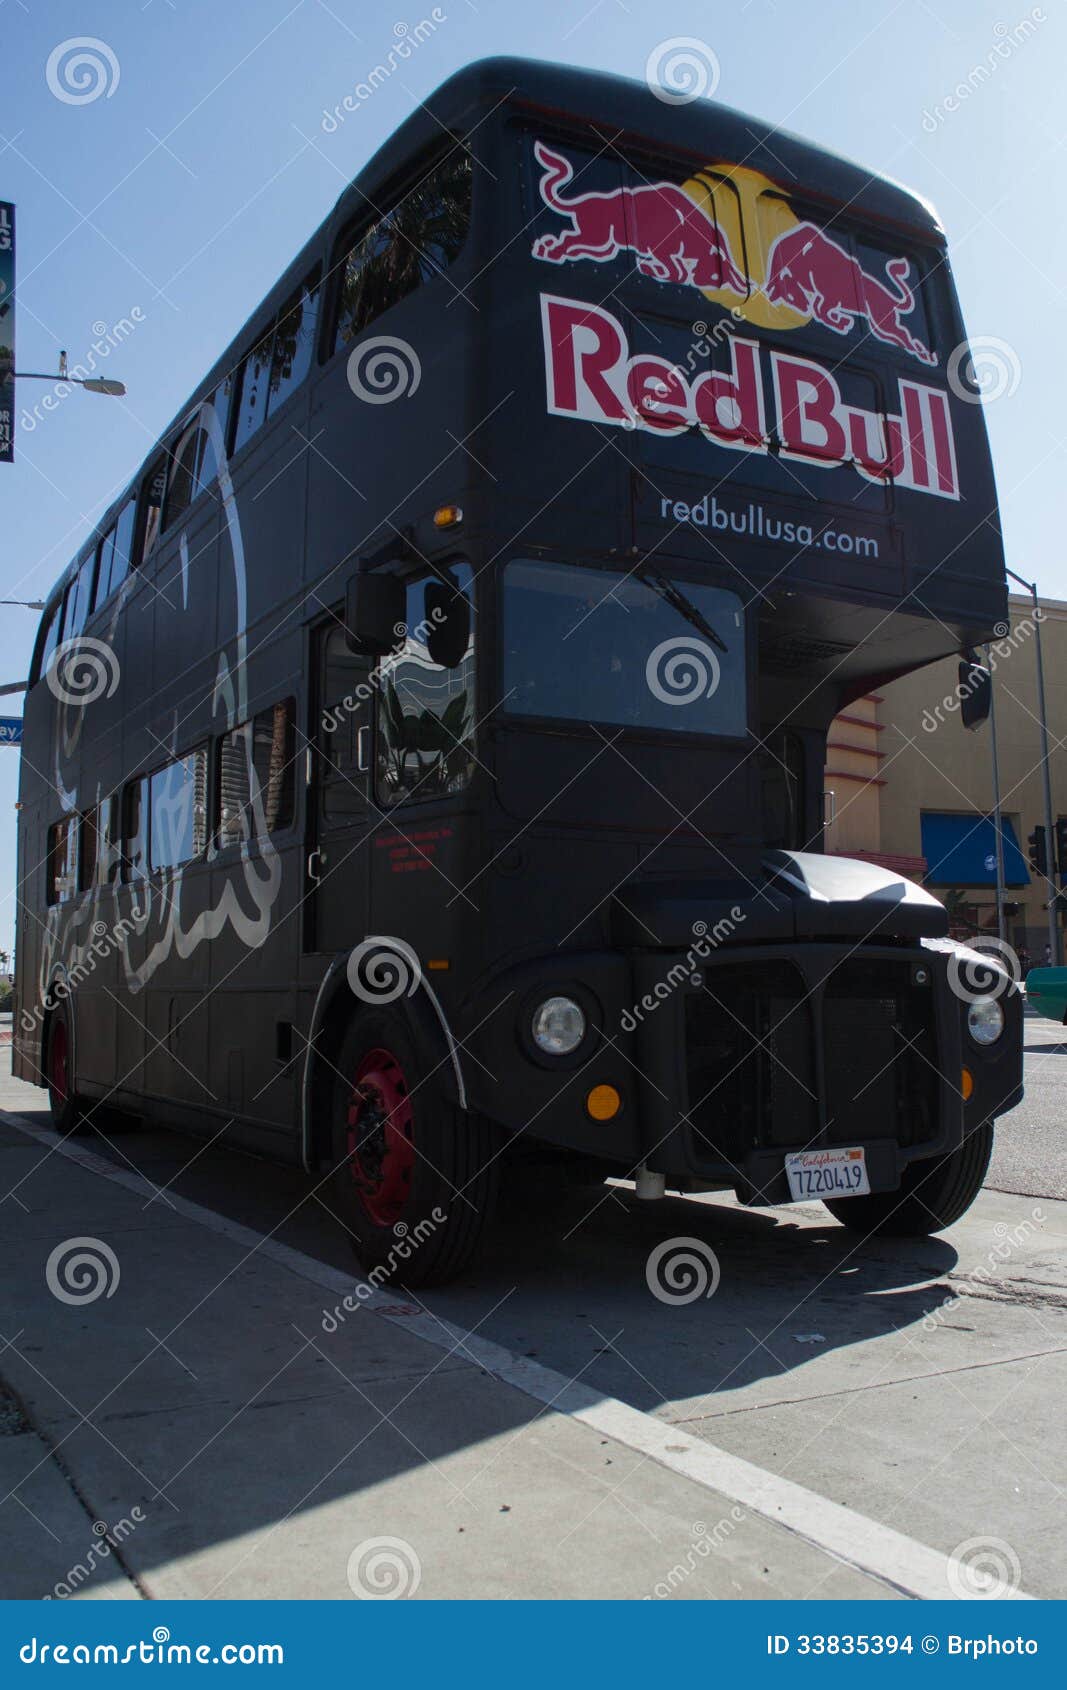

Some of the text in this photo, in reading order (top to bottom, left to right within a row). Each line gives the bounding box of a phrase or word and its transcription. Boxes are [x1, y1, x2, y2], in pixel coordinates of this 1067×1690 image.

[540, 293, 960, 501] Red Bull
[660, 496, 880, 558] redbullusa.com
[793, 1165, 862, 1194] 7Z20419
